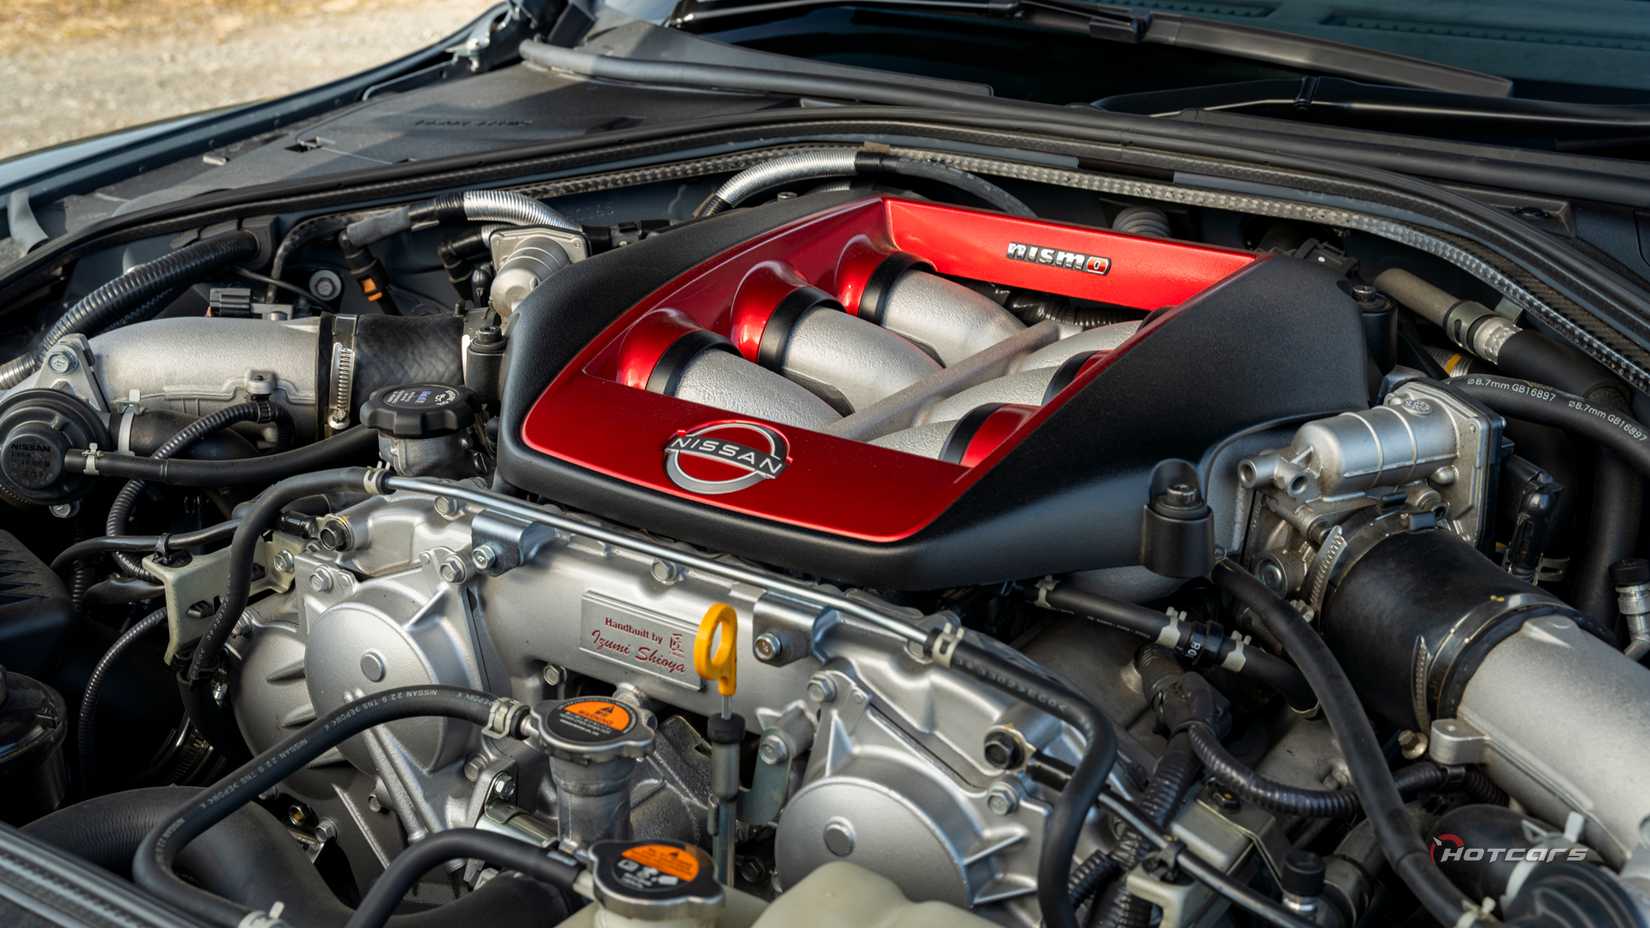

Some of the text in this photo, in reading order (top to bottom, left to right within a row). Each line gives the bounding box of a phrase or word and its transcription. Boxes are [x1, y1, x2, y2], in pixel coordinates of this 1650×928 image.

[1511, 382, 1557, 401] GB16897
[1607, 414, 1648, 442] GB16897
[671, 438, 783, 474] NISSAN
[605, 616, 664, 645] Handbuilt by
[591, 629, 687, 673] Izumi Shioya
